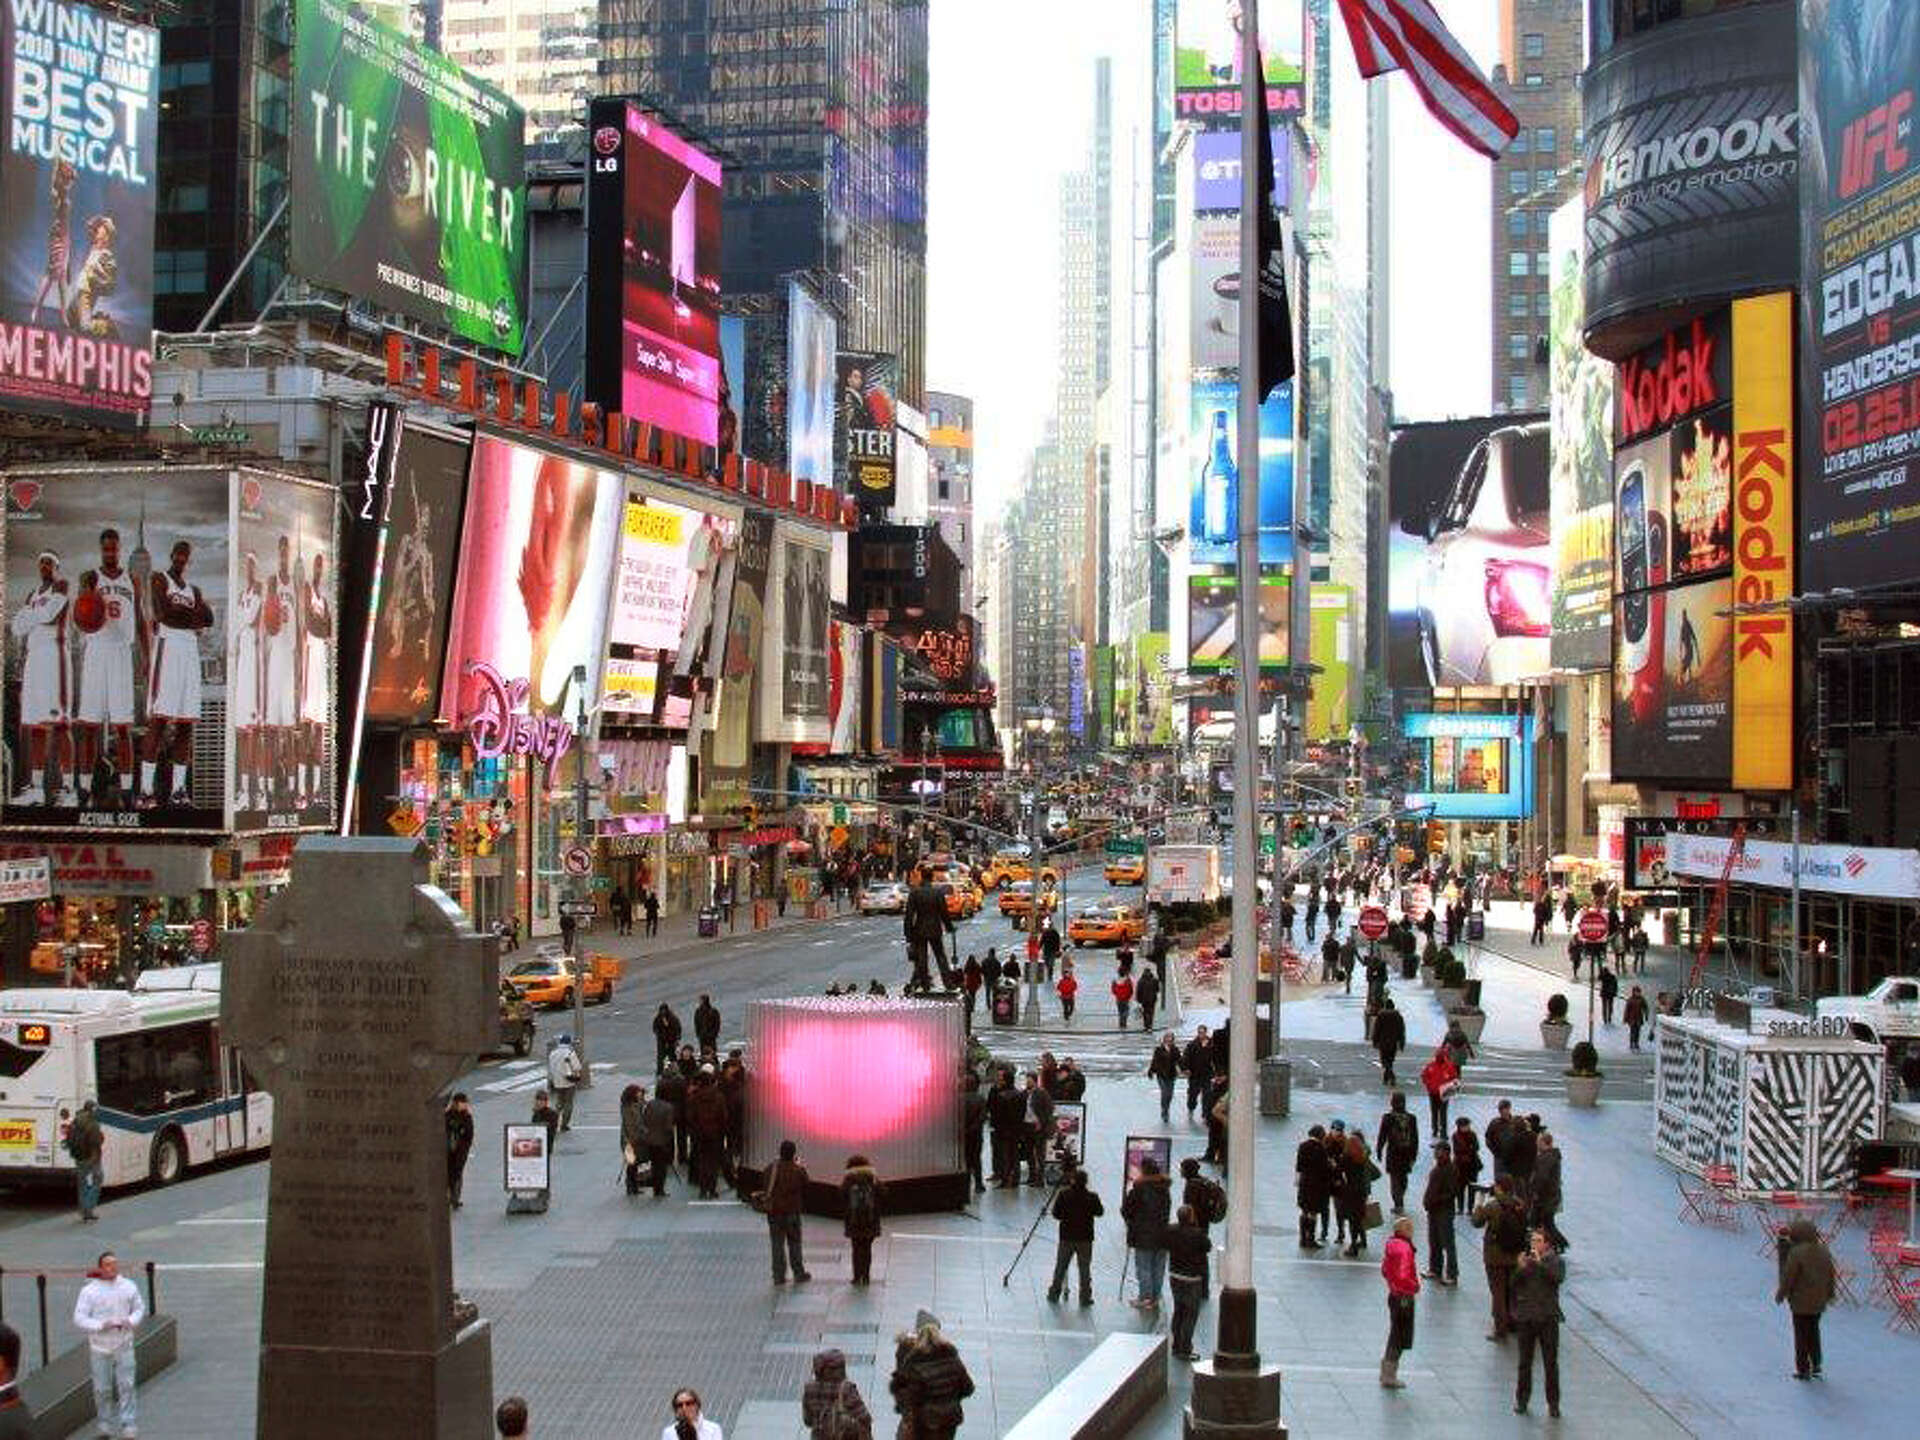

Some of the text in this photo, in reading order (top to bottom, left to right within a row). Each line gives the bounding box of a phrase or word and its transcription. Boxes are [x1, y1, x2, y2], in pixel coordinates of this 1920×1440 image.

[12, 0, 158, 68] WINNER!
[12, 57, 149, 147] BEST
[1175, 88, 1302, 114] TOSBA
[12, 118, 147, 185] MUSICAL
[311, 89, 514, 253] THE RIVER
[596, 157, 618, 173] LG
[1686, 158, 1797, 190] emotion
[1838, 89, 1914, 200] UFC
[0, 322, 150, 397] MEMPHIS
[1620, 316, 1716, 443] Kodak
[1737, 429, 1786, 661] Kodak
